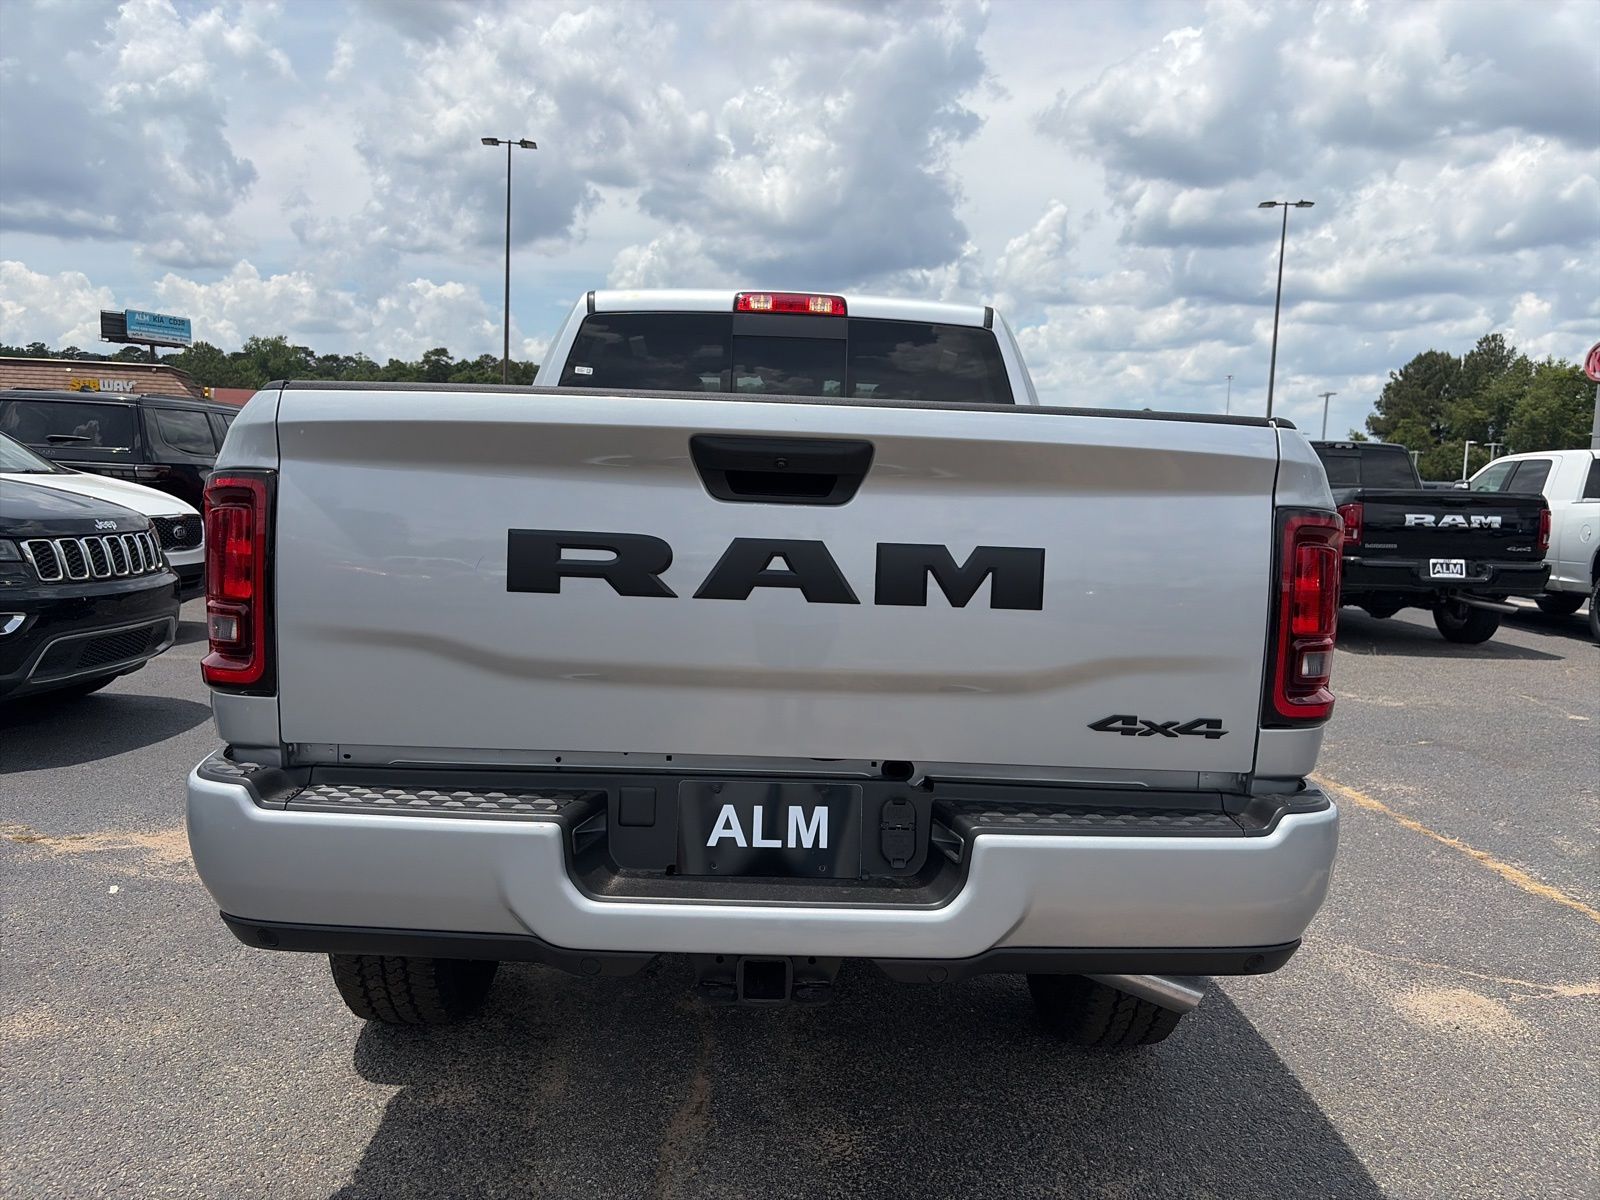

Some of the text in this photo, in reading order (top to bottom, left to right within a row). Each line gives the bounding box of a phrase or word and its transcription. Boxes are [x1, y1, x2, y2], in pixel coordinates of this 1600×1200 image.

[95, 519, 117, 530] Jeep
[1404, 513, 1502, 529] RAM
[506, 528, 1046, 611] RAM
[1433, 563, 1461, 574] ALM
[1087, 714, 1230, 740] 4x4
[706, 803, 829, 850] ALM
